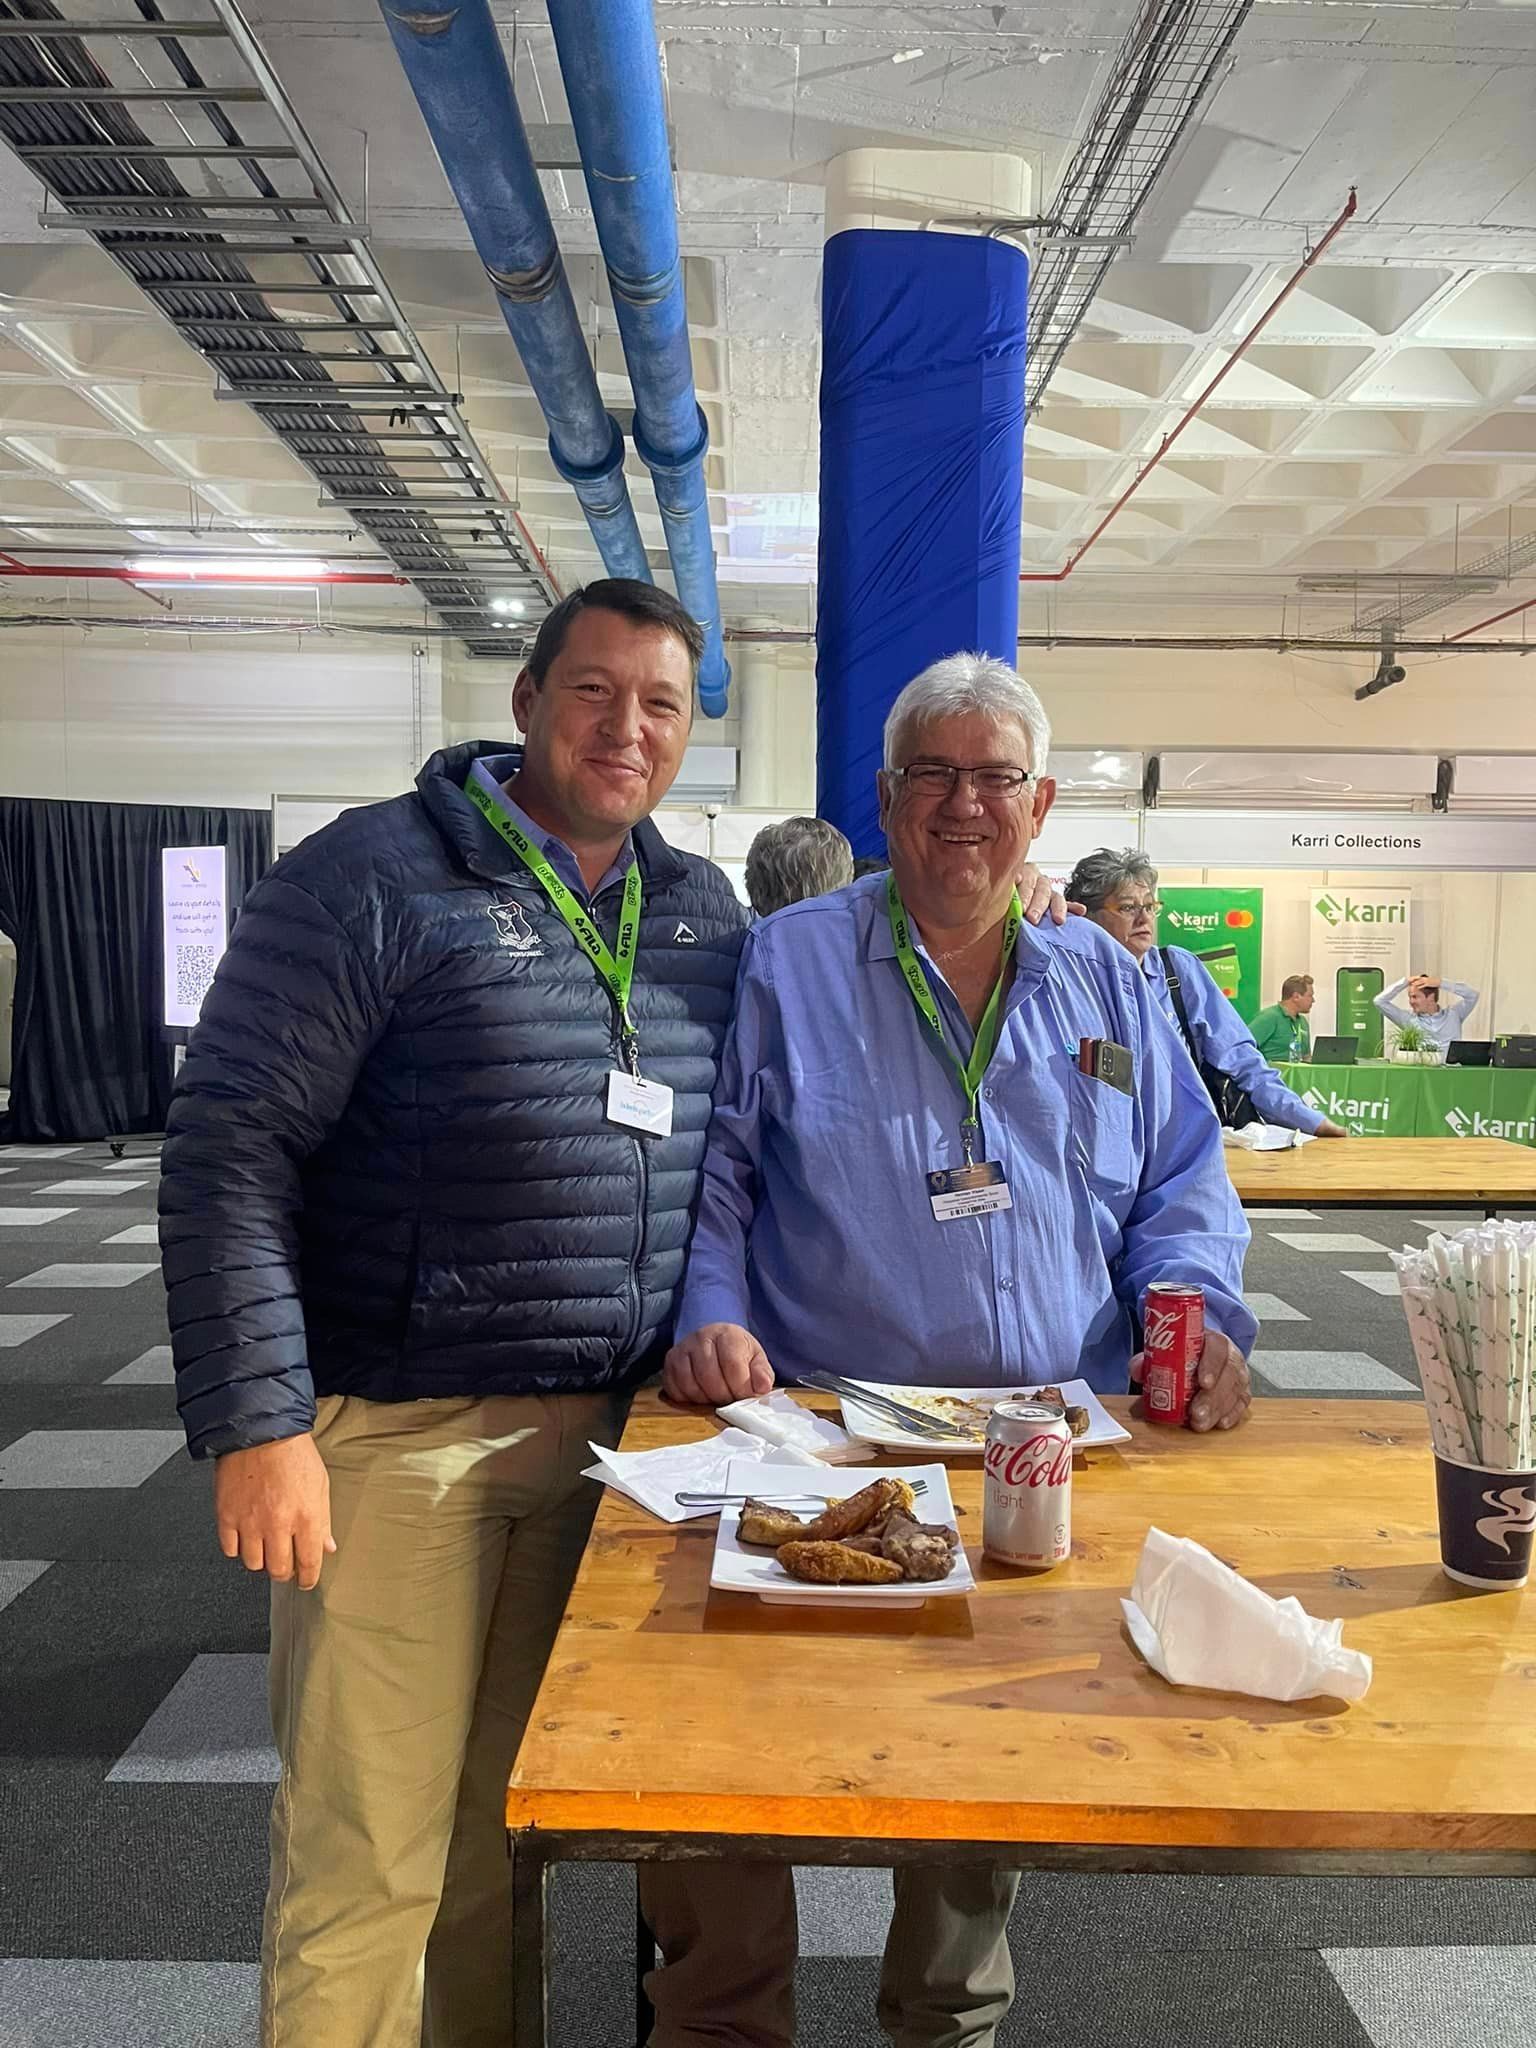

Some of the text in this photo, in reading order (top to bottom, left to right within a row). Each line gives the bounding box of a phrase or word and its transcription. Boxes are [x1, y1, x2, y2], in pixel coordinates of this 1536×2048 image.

[1292, 833, 1422, 848] Karri Collections
[1183, 911, 1219, 926] karri
[1345, 898, 1406, 923] karri
[1329, 1091, 1390, 1121] karri
[1473, 1111, 1536, 1140] karri
[993, 1488, 1025, 1510] light
